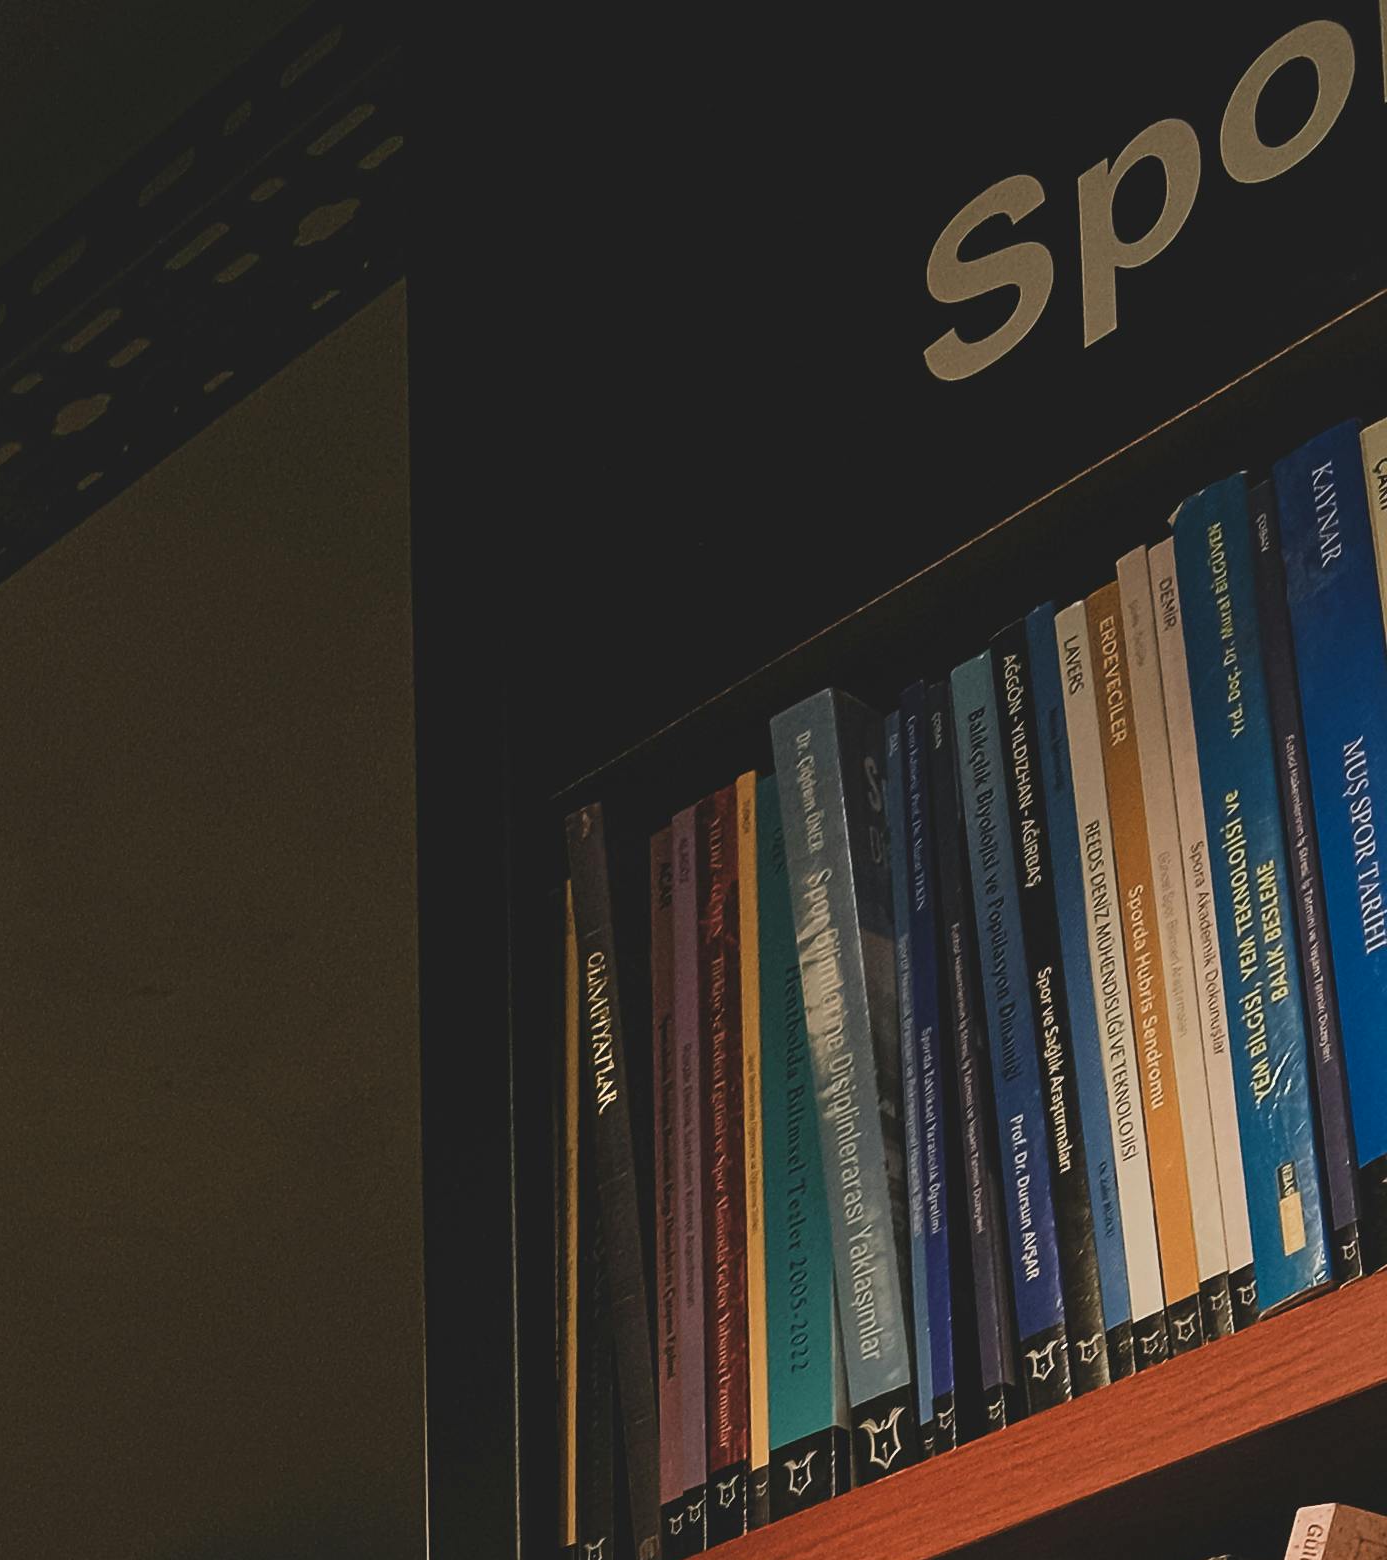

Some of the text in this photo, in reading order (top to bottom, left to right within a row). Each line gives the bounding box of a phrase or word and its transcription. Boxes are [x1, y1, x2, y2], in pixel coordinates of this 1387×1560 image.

[923, 0, 1387, 381] Spo
[1311, 460, 1342, 568] KAYNAR
[1064, 635, 1083, 696] LAVERS
[1342, 734, 1367, 796] MUŞ
[1350, 799, 1381, 865] SPOR
[1035, 967, 1055, 1005] Spor
[1040, 1007, 1056, 1025] ve
[1125, 885, 1148, 951] Sporda
[1139, 1015, 1165, 1111] Sendromu
[1008, 1114, 1041, 1282] Prof. Dr. Dursun AVŞAR
